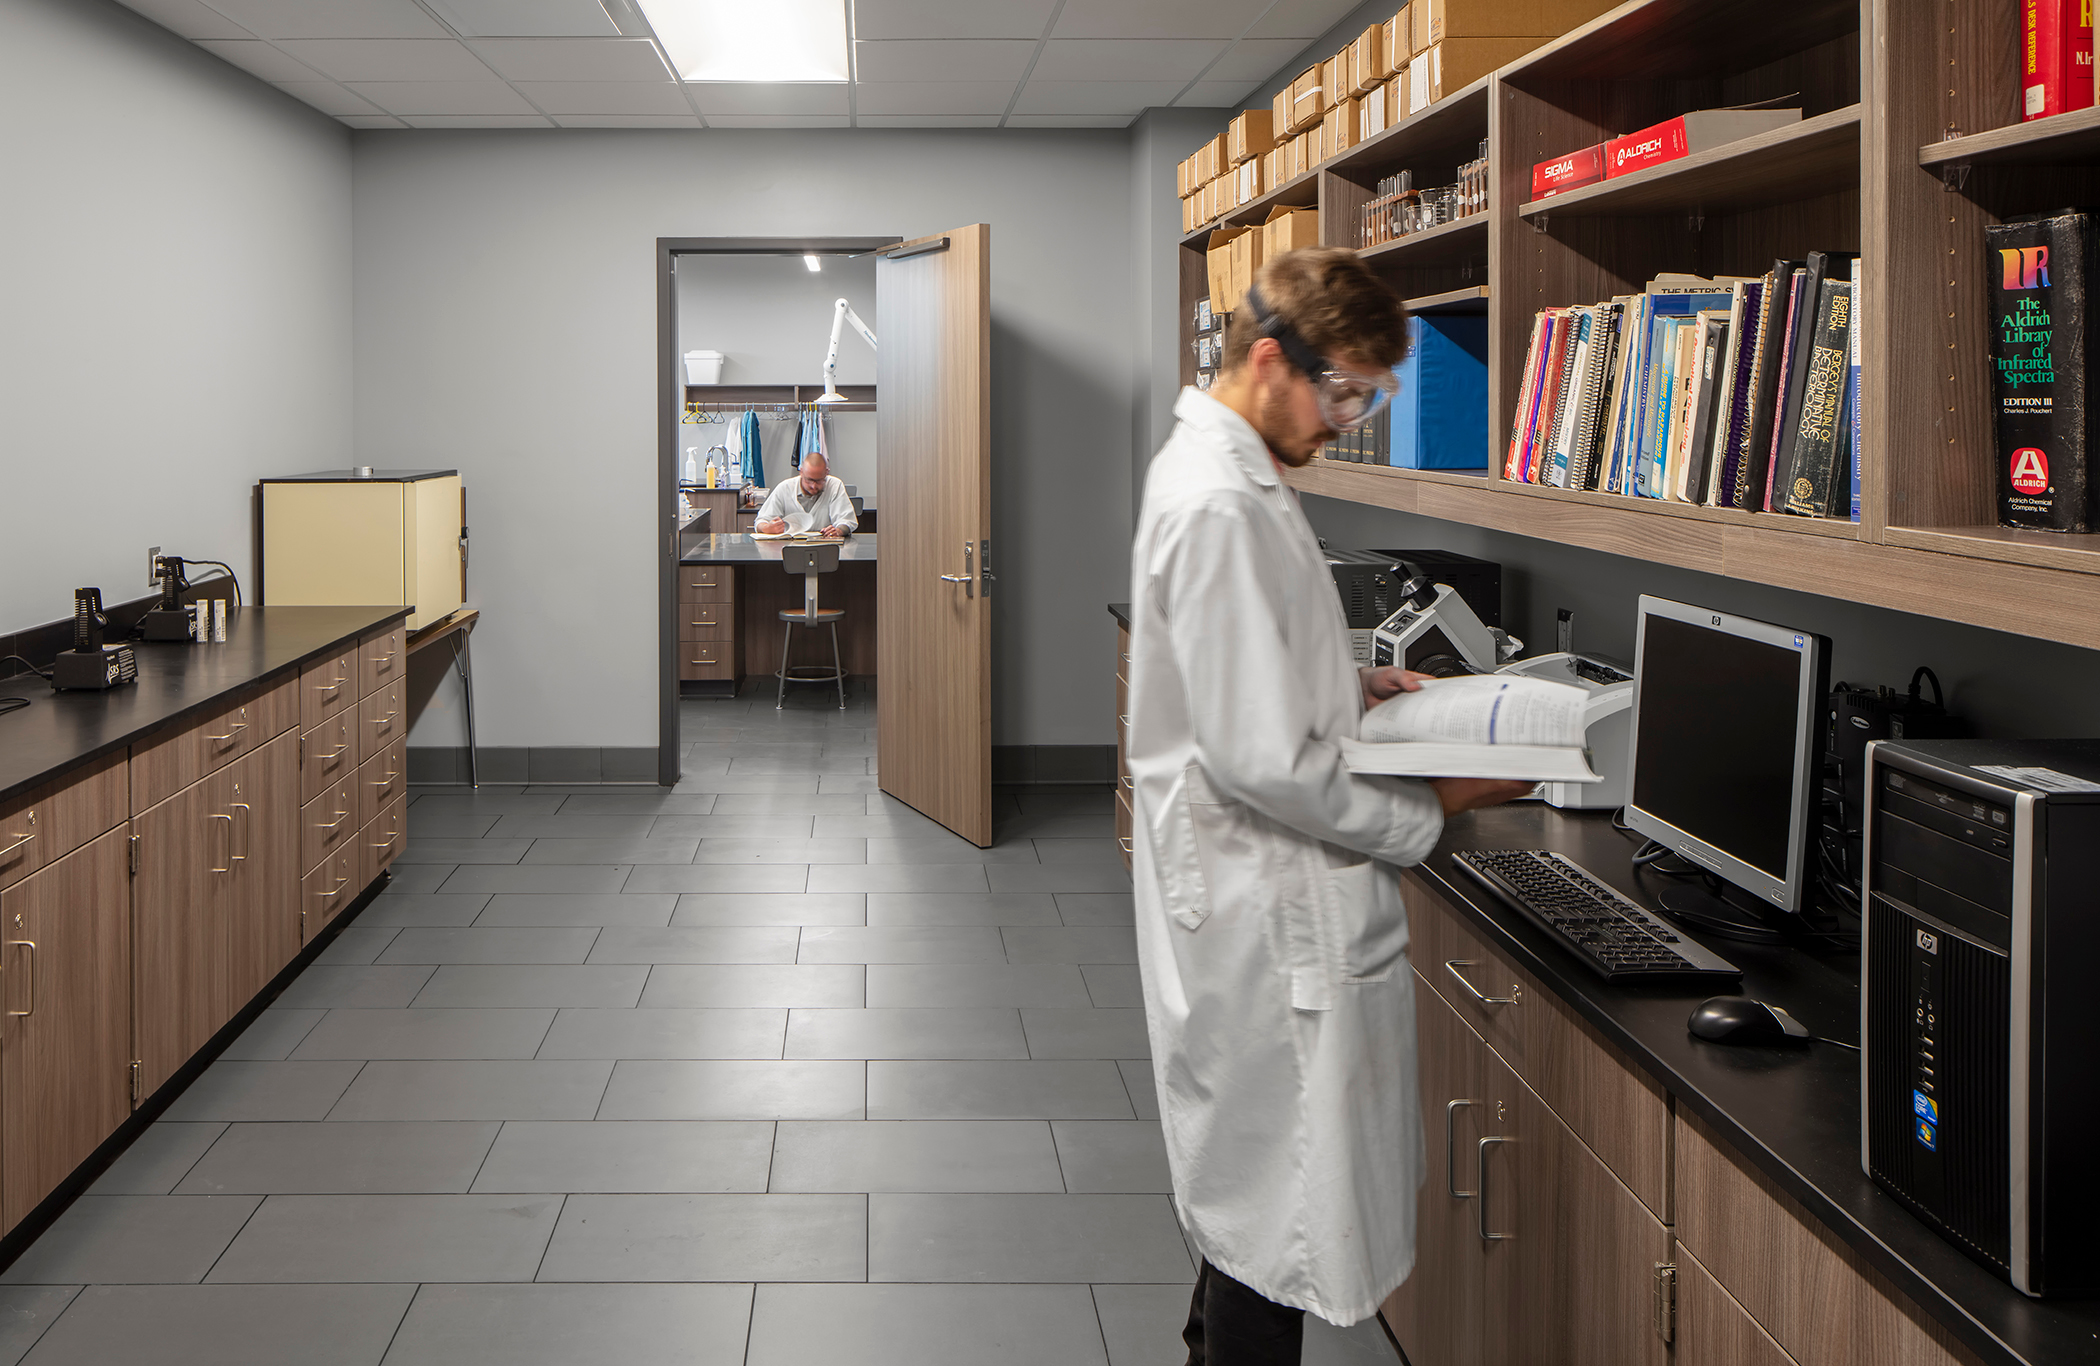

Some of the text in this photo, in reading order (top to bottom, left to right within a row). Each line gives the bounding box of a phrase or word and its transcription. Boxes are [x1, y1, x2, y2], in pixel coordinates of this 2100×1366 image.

[2028, 9, 2036, 30] DESK
[2028, 30, 2036, 75] REFERENCE
[1626, 138, 1662, 159] ALDRICH
[1644, 151, 1661, 160] Chemistry
[1545, 160, 1573, 179] SIGMA
[1828, 295, 1840, 330] EDITION
[1837, 296, 1849, 328] EIGHTH
[2016, 297, 2040, 310] The
[2001, 310, 2050, 327] Aldrich
[2005, 327, 2052, 347] Library
[2032, 342, 2044, 357] of
[1998, 353, 2052, 370] Infrared
[1650, 362, 1658, 395] Macroscale
[2004, 370, 2054, 389] Spectra
[1681, 337, 1697, 450] Analytical Chemistry
[1800, 345, 1823, 438] BACTERIOLOGY
[1808, 347, 1833, 440] DETERMINATIVE
[1820, 349, 1843, 443] BERGEY'S MANUAL OF
[2003, 398, 2052, 406] EDITION III
[1601, 404, 1609, 435] CHEMISTRY
[2012, 450, 2046, 479] A
[2014, 479, 2046, 488] ALDRICH
[2028, 498, 2052, 506] Chemical
